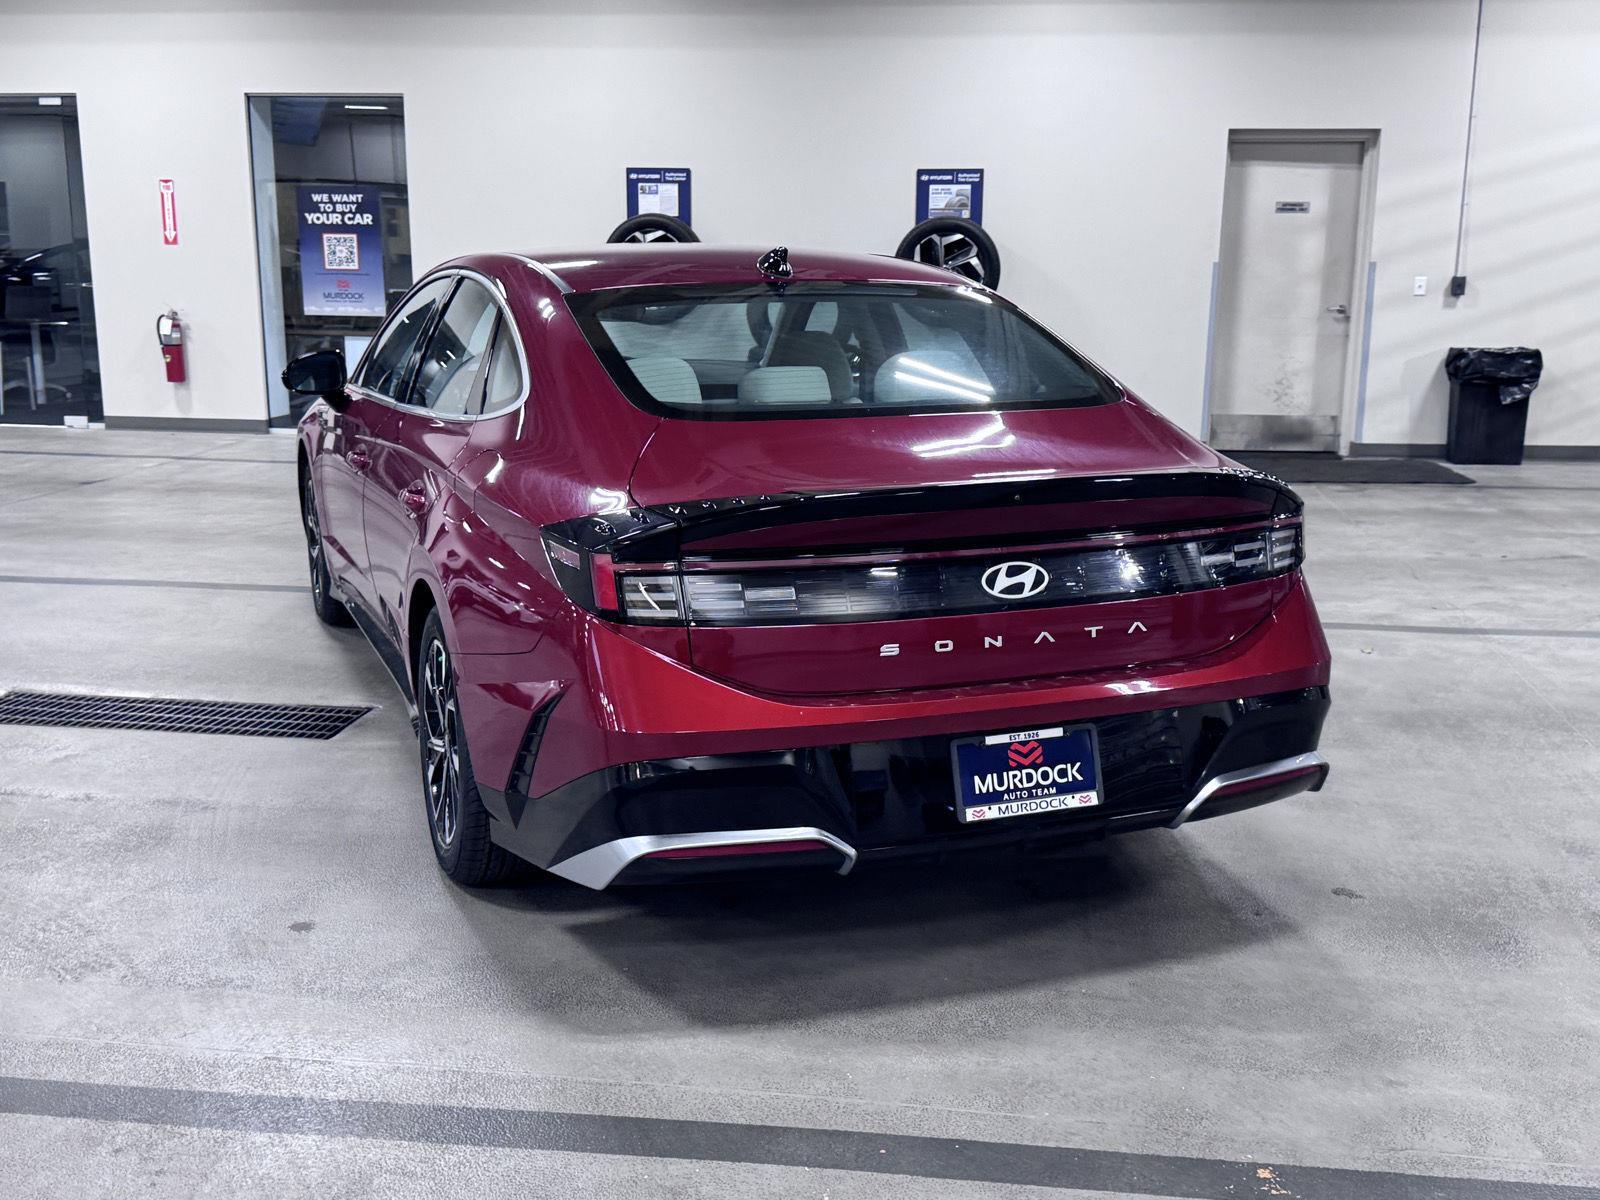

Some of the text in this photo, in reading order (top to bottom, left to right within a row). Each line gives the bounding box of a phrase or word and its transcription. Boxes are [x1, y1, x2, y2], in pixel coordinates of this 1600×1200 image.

[311, 194, 363, 202] WE WANT
[318, 203, 357, 212] TO BUY
[304, 213, 373, 225] YOUR CAR
[879, 621, 1147, 657] SONATA
[1008, 731, 1040, 741] EST. 1926
[973, 761, 1084, 794] MURDOCK
[1003, 786, 1057, 800] AUTO TEAM
[997, 796, 1069, 816] MURDOCK
